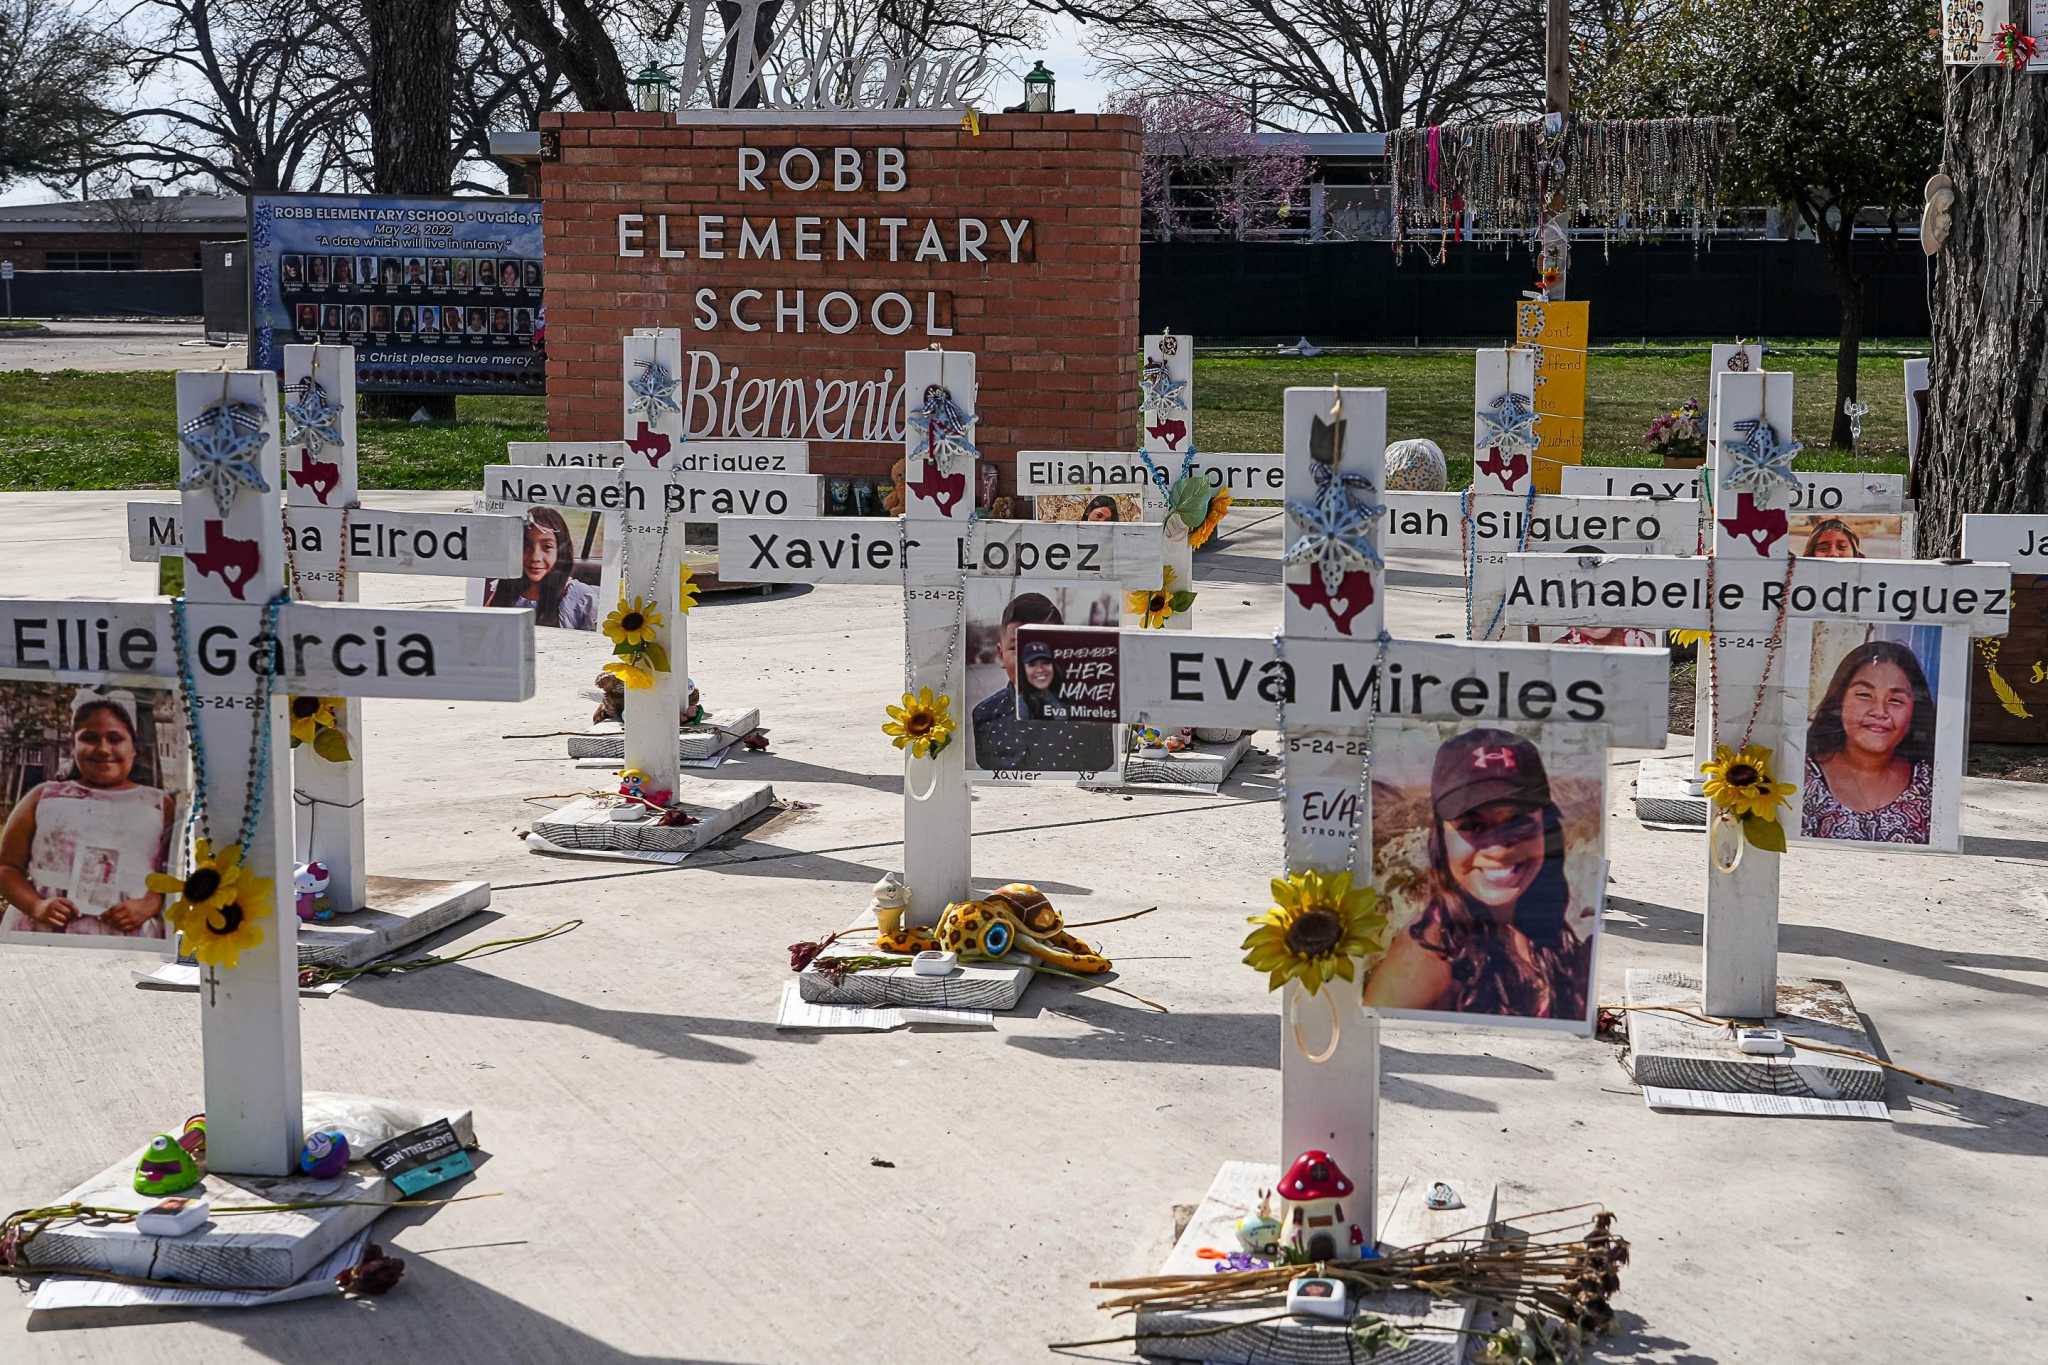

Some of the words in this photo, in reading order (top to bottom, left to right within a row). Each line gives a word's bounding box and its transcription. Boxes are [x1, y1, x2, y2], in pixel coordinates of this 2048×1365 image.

[678, 0, 987, 112] Welcome
[738, 147, 907, 192] ROBB
[275, 207, 313, 218] ROBB
[316, 208, 404, 220] ELEMENTARY
[407, 210, 465, 222] SCHOOL
[477, 212, 530, 225] Uvalde,
[533, 213, 543, 224] T
[332, 236, 361, 247] date
[363, 238, 399, 248] which
[403, 239, 421, 248] will
[425, 239, 445, 249] live
[448, 240, 459, 249] in
[374, 224, 400, 236] May
[424, 225, 453, 235] 2022
[618, 213, 1032, 264] ELEMENTARY
[694, 289, 953, 336] SCHOOL
[370, 352, 407, 362] Christ
[411, 353, 454, 365] please
[458, 354, 488, 364] have
[492, 356, 534, 367] mercy.
[683, 350, 907, 440] Bienveni
[682, 454, 786, 471] driguez
[1029, 461, 1169, 485] Eliahana
[1187, 463, 1284, 488] Torre
[501, 478, 645, 511] Nevaeh
[664, 483, 788, 515] Bravo
[1390, 508, 1448, 537] lah
[1477, 511, 1661, 542] Silguero
[350, 522, 468, 561] Elrod
[749, 532, 920, 570] Xavier
[957, 536, 1100, 577] Lopez
[2018, 530, 2048, 556] Ja
[1507, 574, 1744, 611] Annabelle
[1762, 580, 2008, 621] Rodriguez
[14, 617, 158, 671] Ellie
[199, 625, 436, 677] Garcia
[1054, 647, 1118, 659] REMEMBER
[1719, 636, 1782, 648] 5-24-22
[1066, 662, 1115, 680] HER
[1059, 681, 1115, 700] NAME!
[1169, 651, 1296, 704] Eva
[1330, 662, 1606, 722] Mireles
[1043, 704, 1067, 717] Eva
[1071, 706, 1117, 718] Mireles
[1290, 738, 1368, 757] 5-24-22
[992, 768, 1042, 781] Xavier
[1302, 788, 1357, 828] EVA
